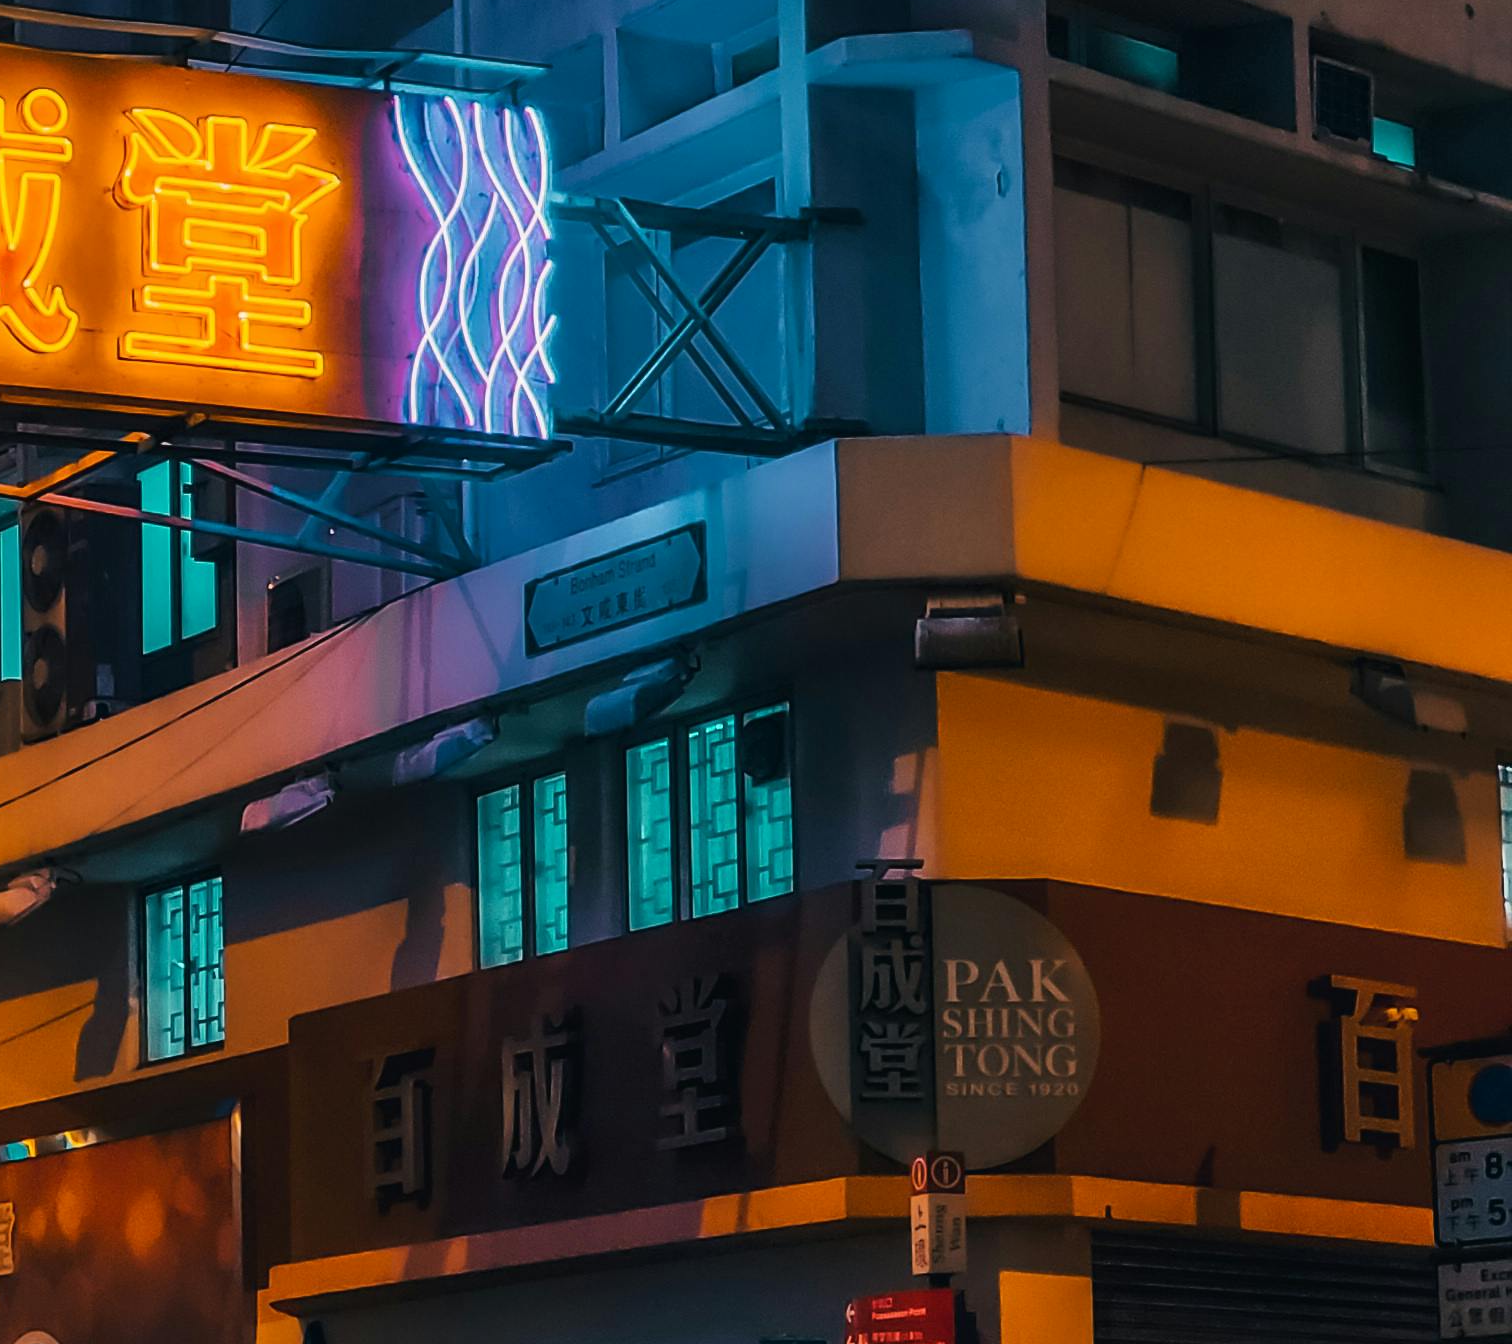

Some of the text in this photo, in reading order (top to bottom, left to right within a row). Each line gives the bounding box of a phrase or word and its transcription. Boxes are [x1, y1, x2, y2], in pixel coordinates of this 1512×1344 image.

[854, 859, 927, 1102] 百成堂
[943, 959, 1071, 1003] PAK
[943, 1008, 1077, 1039] SHING
[944, 1043, 1078, 1077] TONG
[1331, 975, 1418, 1150] 百
[368, 972, 733, 1213] 百成堂
[946, 1082, 1079, 1096] SINCE 1920
[1449, 1151, 1471, 1163] am
[1451, 1197, 1473, 1212] pm
